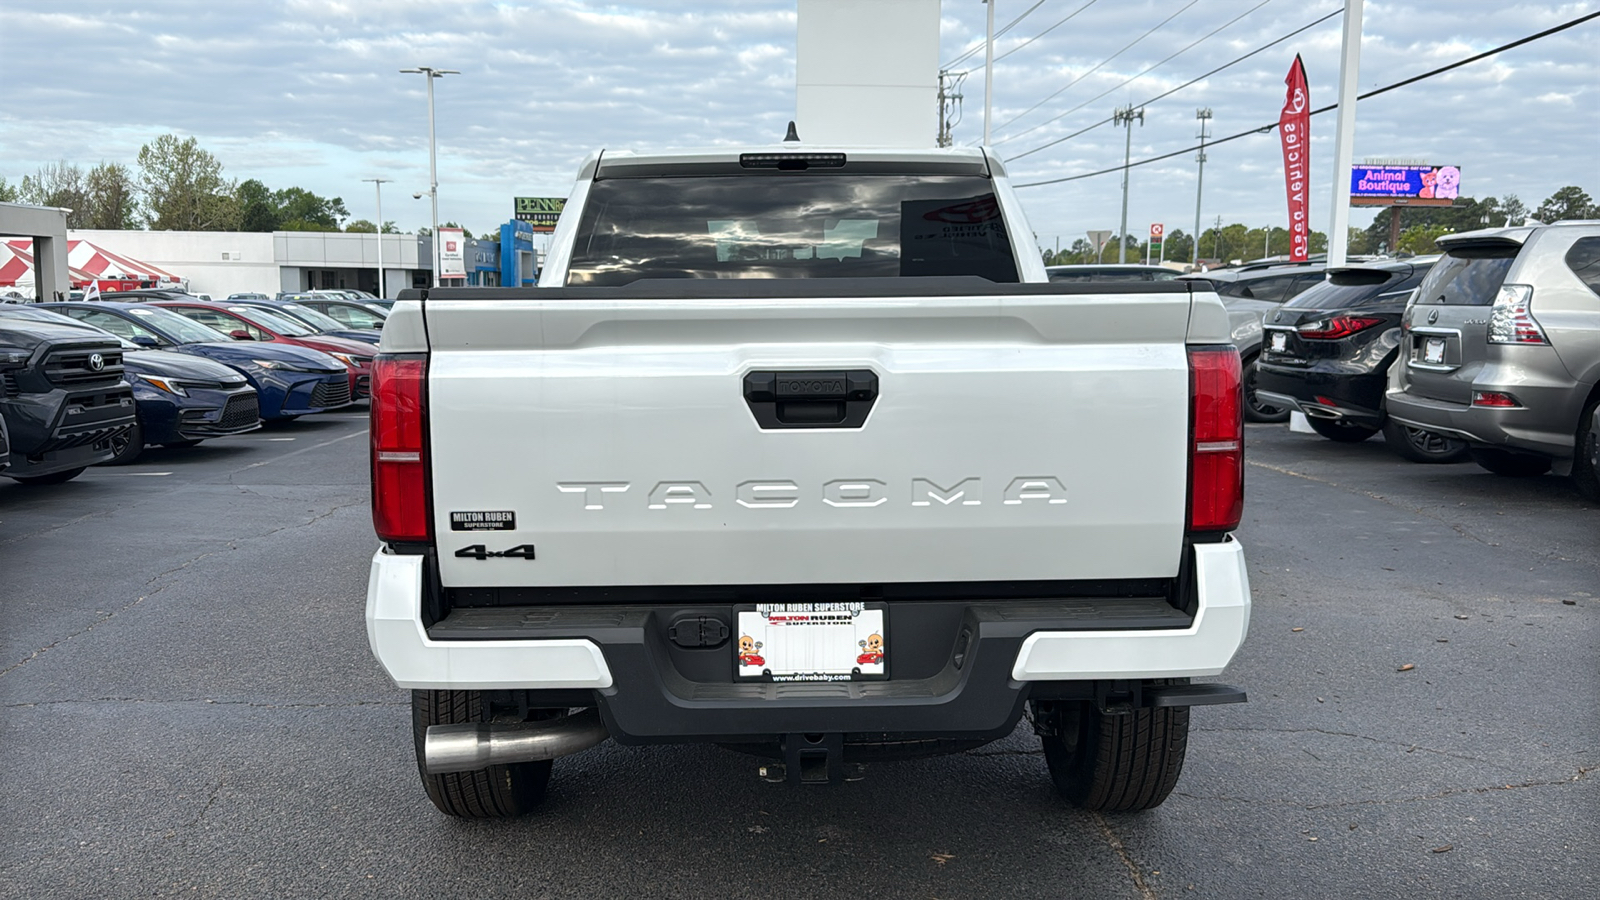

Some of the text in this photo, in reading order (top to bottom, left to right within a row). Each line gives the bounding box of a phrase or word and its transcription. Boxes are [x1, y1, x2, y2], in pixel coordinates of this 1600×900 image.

[1364, 170, 1406, 181] Animal
[1358, 180, 1411, 194] Boutique
[780, 381, 843, 393] TOYOTA
[556, 476, 1068, 509] TACOMA
[453, 512, 512, 522] MILTON RUBEN
[756, 602, 865, 612] MILTON RUBEN SUPERSTORE
[772, 673, 851, 682] www.drivebaby.com
